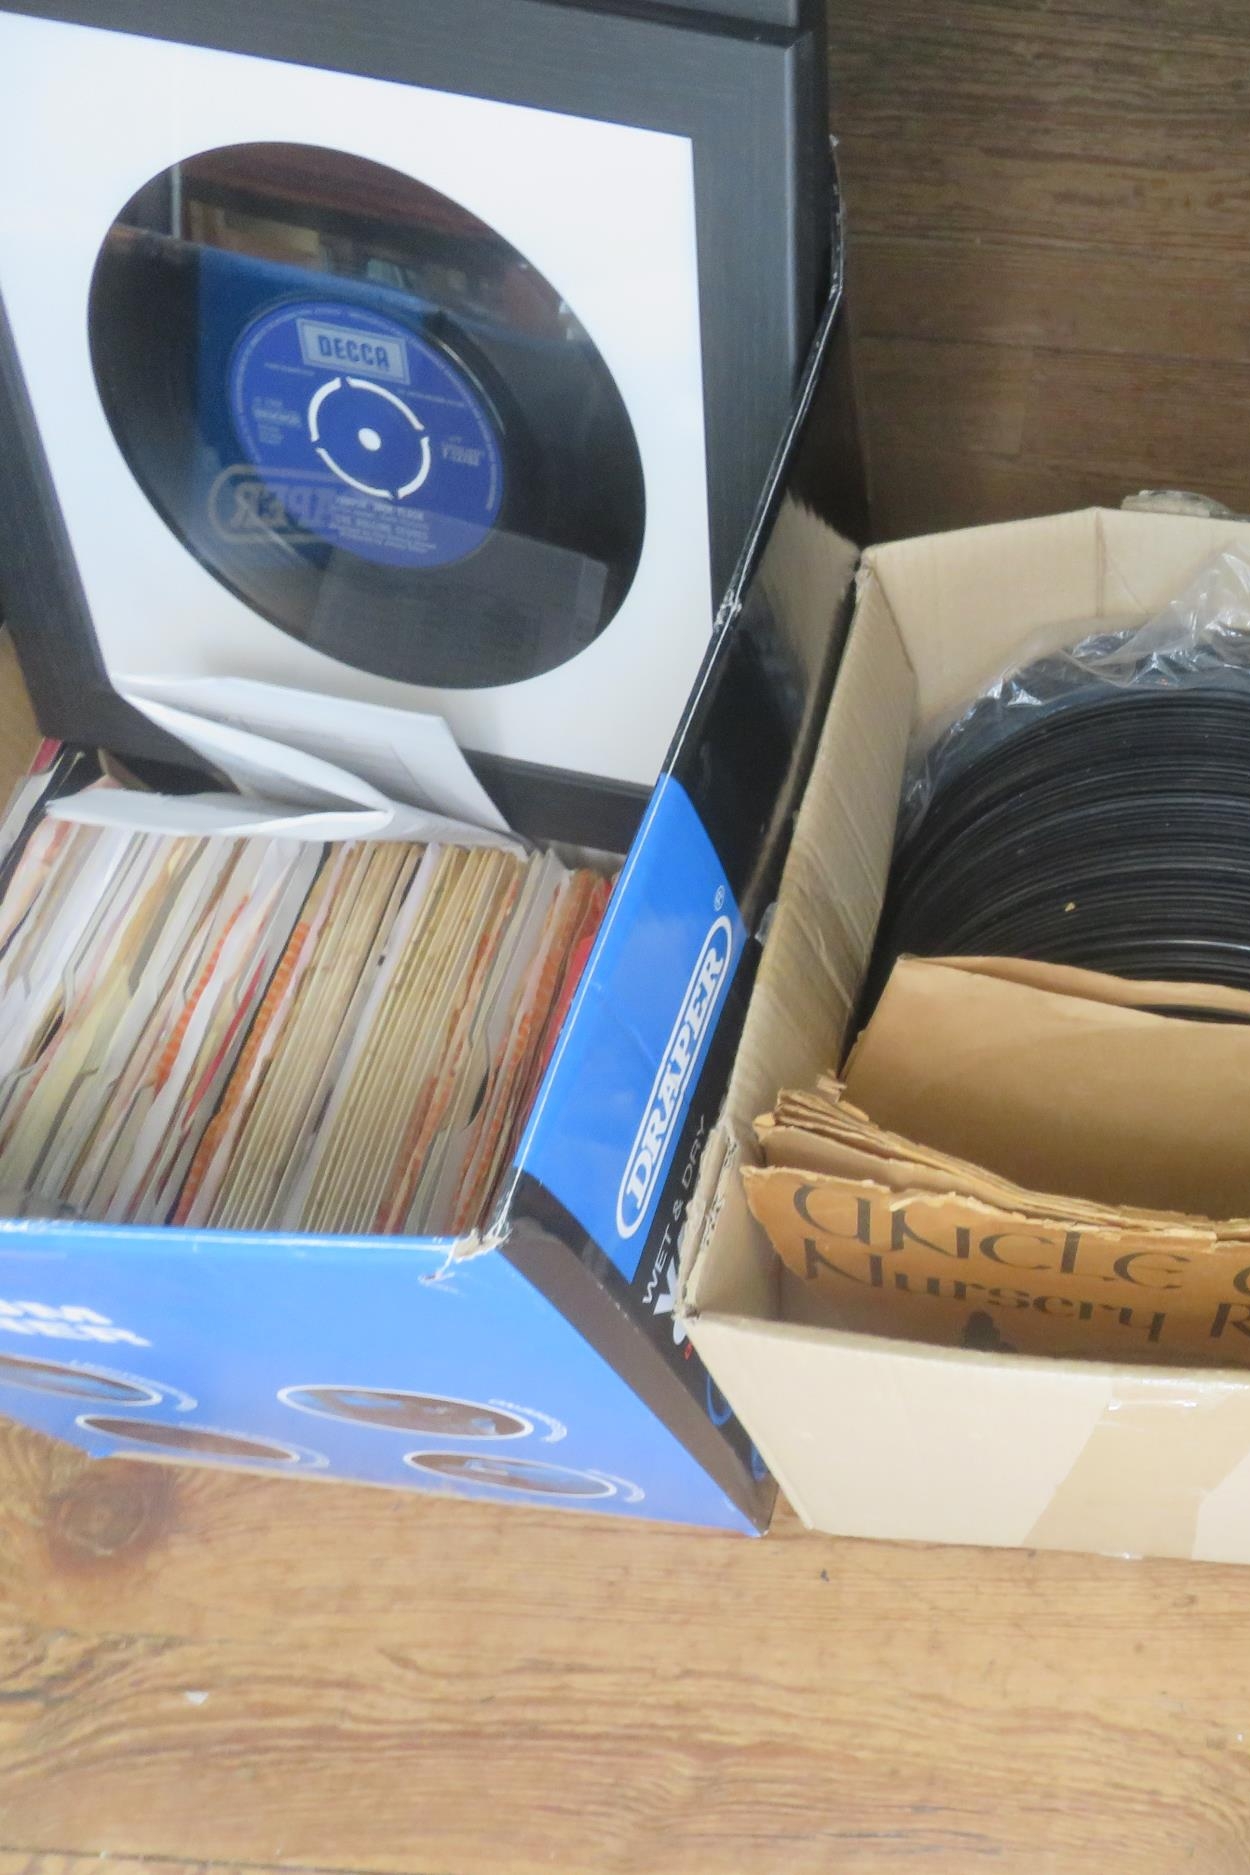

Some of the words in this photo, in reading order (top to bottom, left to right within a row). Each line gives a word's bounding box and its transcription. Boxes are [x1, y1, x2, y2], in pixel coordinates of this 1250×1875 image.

[317, 334, 390, 369] DECCA
[626, 947, 724, 1209] DRAPER
[642, 1223, 671, 1303] WET
[793, 1183, 1191, 1289] UNCLE
[804, 1237, 1166, 1343] Nursery
